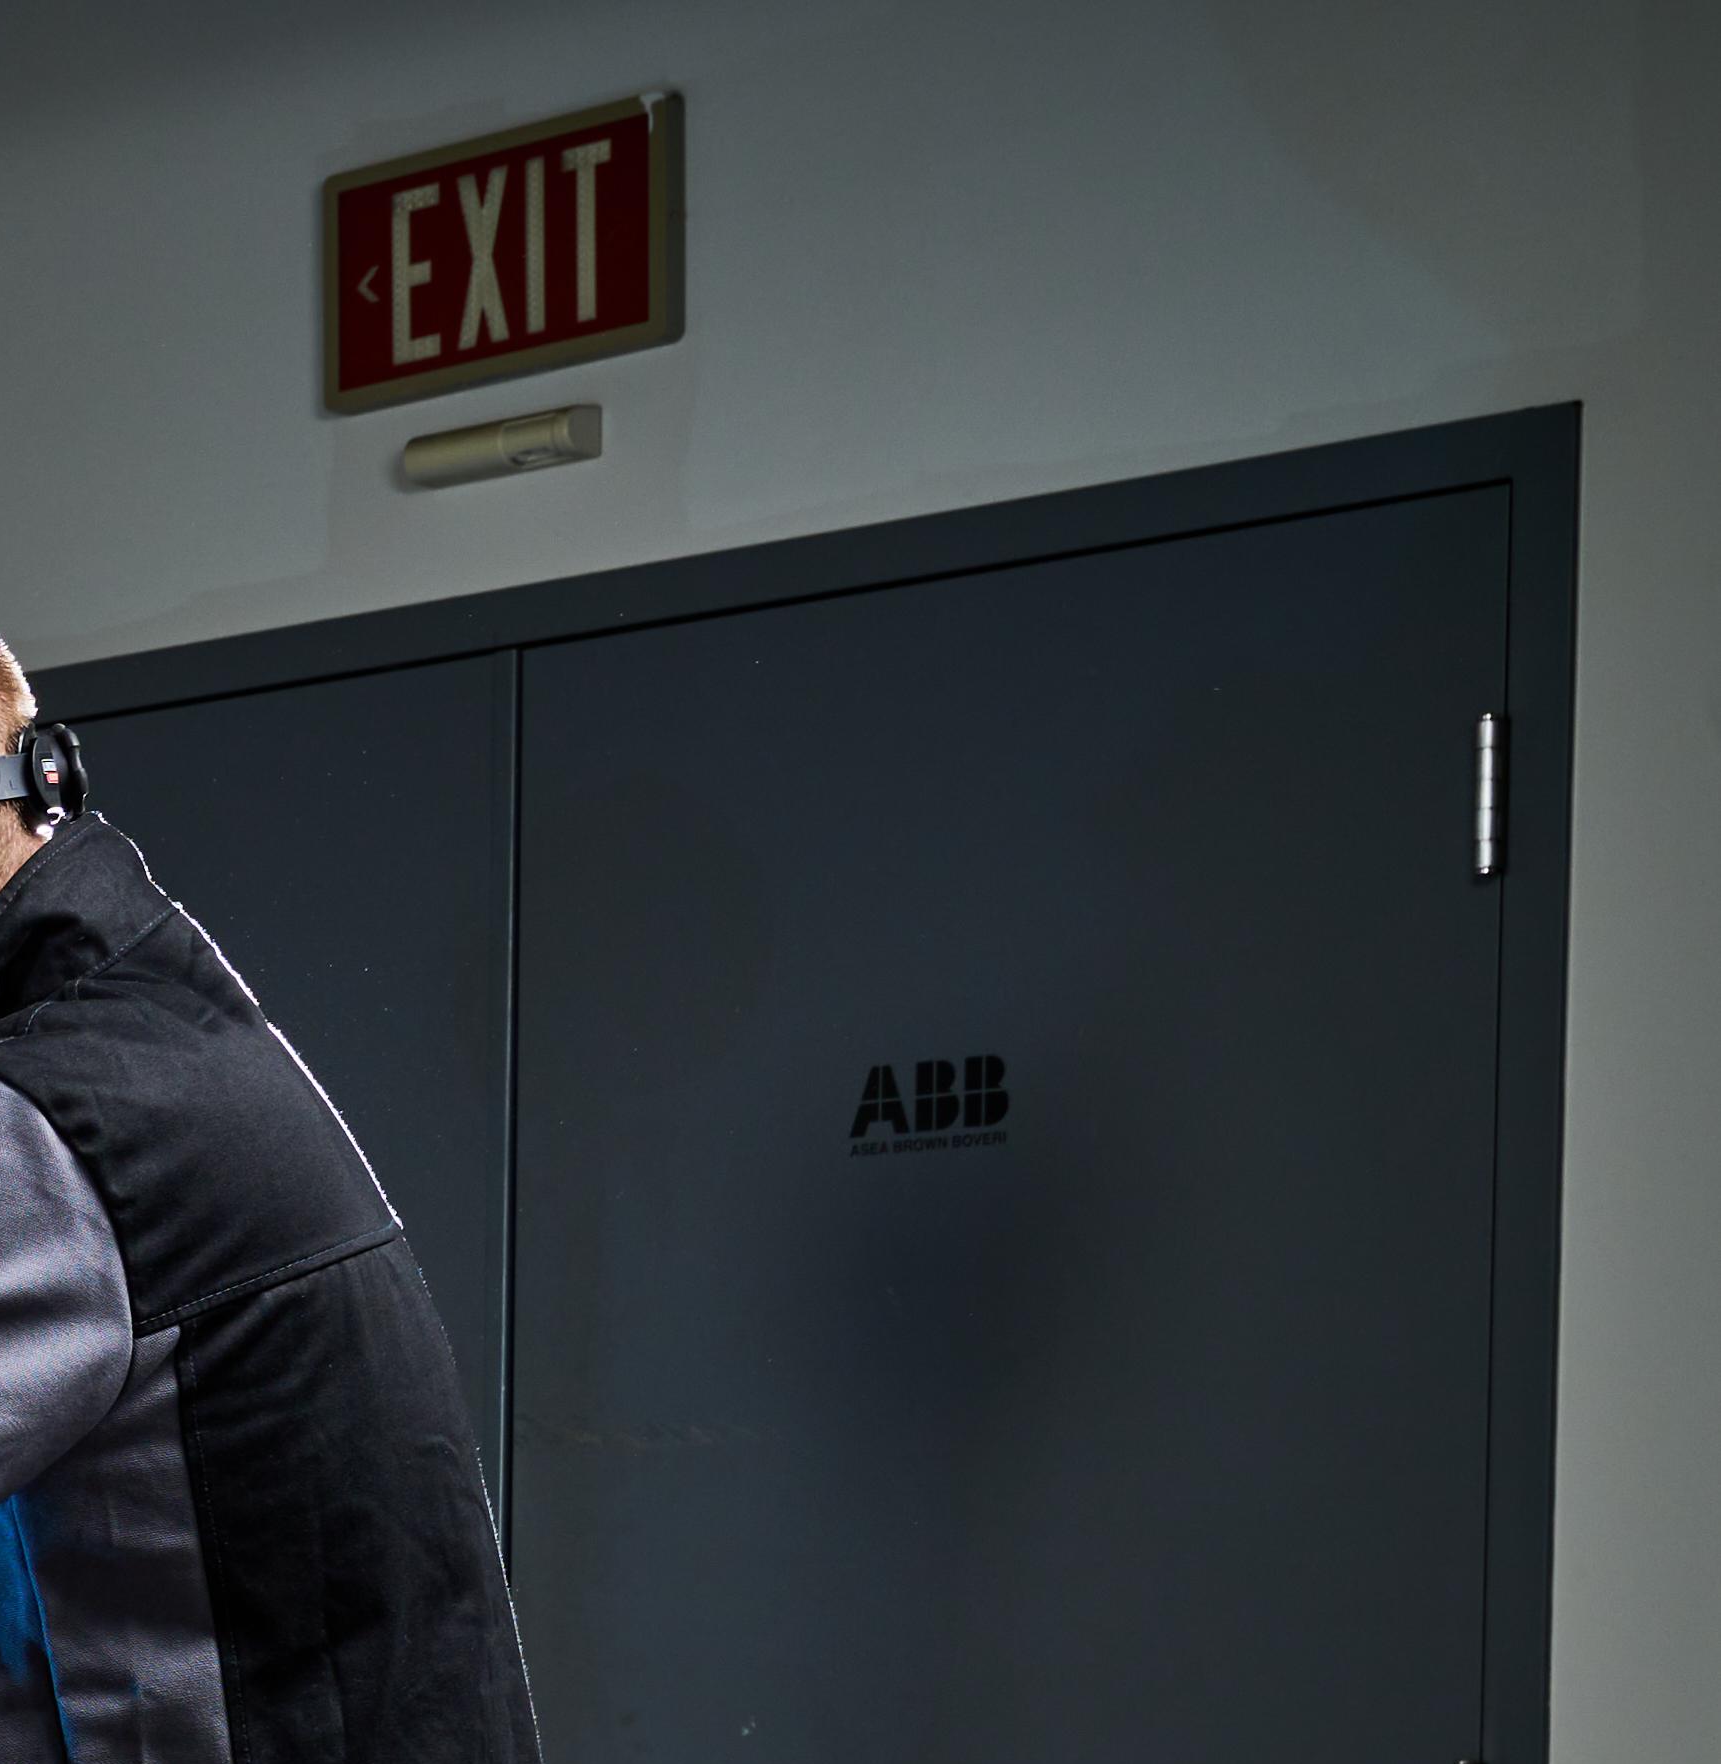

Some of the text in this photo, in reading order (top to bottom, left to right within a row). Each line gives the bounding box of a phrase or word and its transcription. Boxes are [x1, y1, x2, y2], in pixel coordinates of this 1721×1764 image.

[391, 138, 612, 367] EXIT
[849, 1053, 1010, 1138] ABB
[850, 1132, 1007, 1158] ASEA BROWN BOVERI
